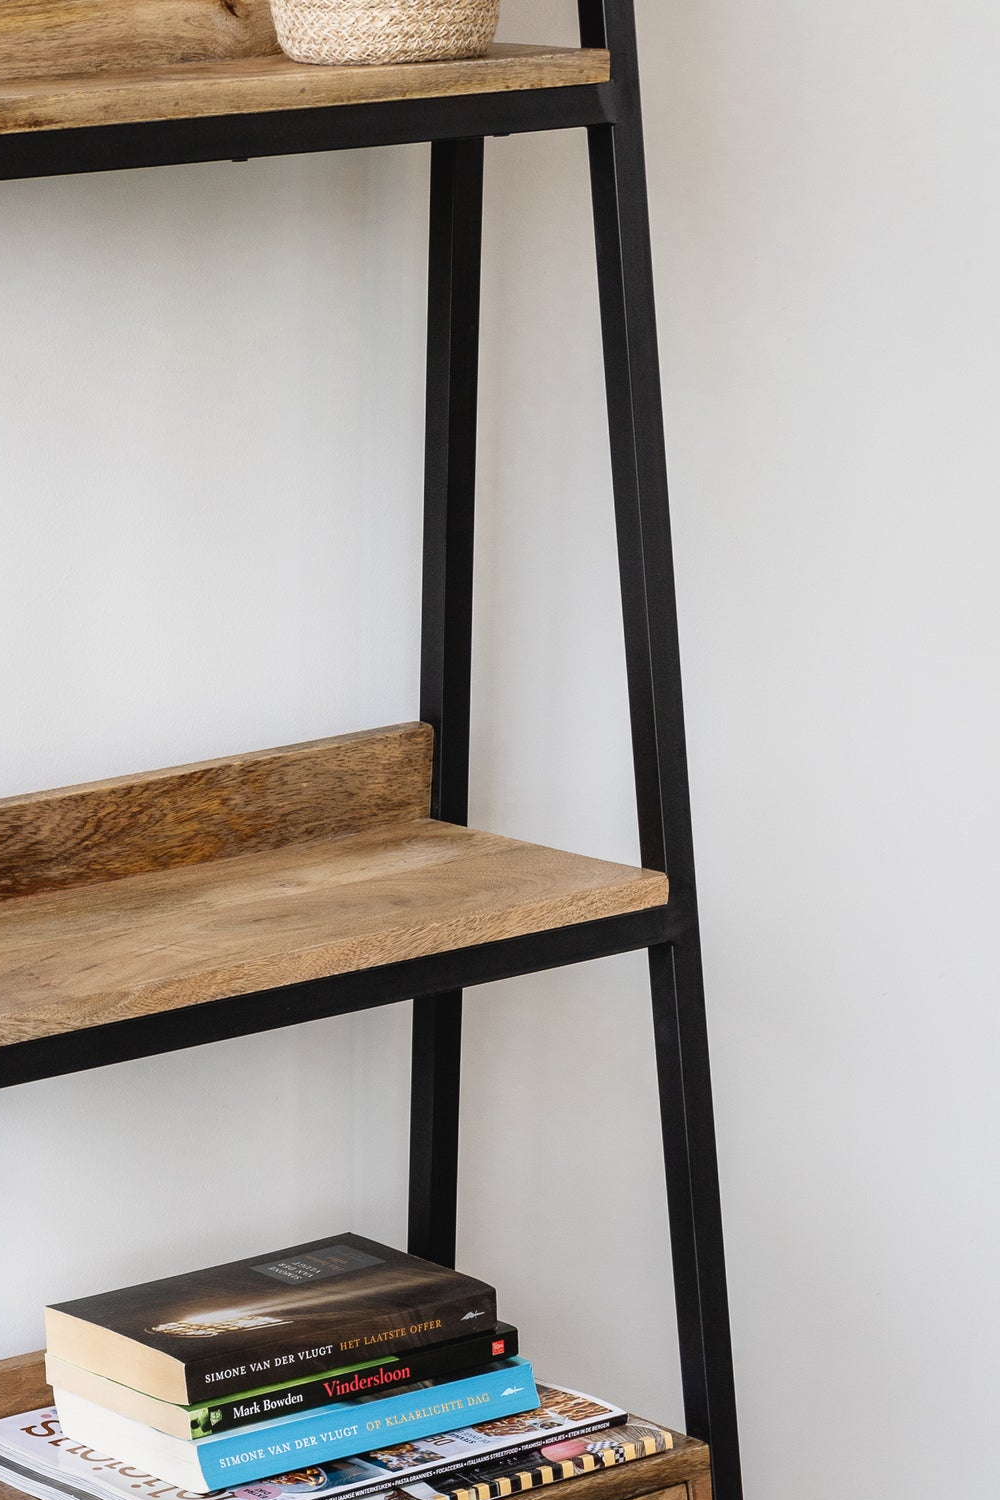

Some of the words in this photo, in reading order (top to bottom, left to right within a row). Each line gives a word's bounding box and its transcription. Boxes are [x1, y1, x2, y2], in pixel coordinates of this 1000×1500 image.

[205, 1366, 247, 1384] SIMONE
[250, 1360, 270, 1372] VAN
[274, 1355, 295, 1367] DER
[298, 1345, 333, 1360] VLUGT
[340, 1339, 360, 1351] HET
[364, 1328, 406, 1345] LAATSTE
[410, 1320, 442, 1334] OFFER
[233, 1402, 260, 1419] Mark
[263, 1393, 303, 1412] Bowden
[323, 1367, 411, 1398] Vindersloon
[220, 1449, 265, 1468] SIMONE
[268, 1442, 290, 1455] VAN
[294, 1436, 318, 1450] DER
[320, 1425, 358, 1442] VLUGT
[366, 1421, 381, 1432] OP
[386, 1400, 464, 1427] KLAARLICHTE
[467, 1392, 490, 1406] DAG
[355, 1482, 392, 1496] WINTERKEUKEN
[395, 1478, 409, 1486] PASTA
[410, 1471, 432, 1482] GRANNIES
[436, 1463, 464, 1474] FOCACCERIA
[466, 1454, 490, 1466] ITALIAANS
[490, 1448, 518, 1460] STREETFOOD
[522, 1441, 542, 1450] TIRAMISU
[546, 1434, 564, 1444] KOEKJES
[568, 1430, 580, 1438] ETEN
[592, 1422, 610, 1432] BERGEN
